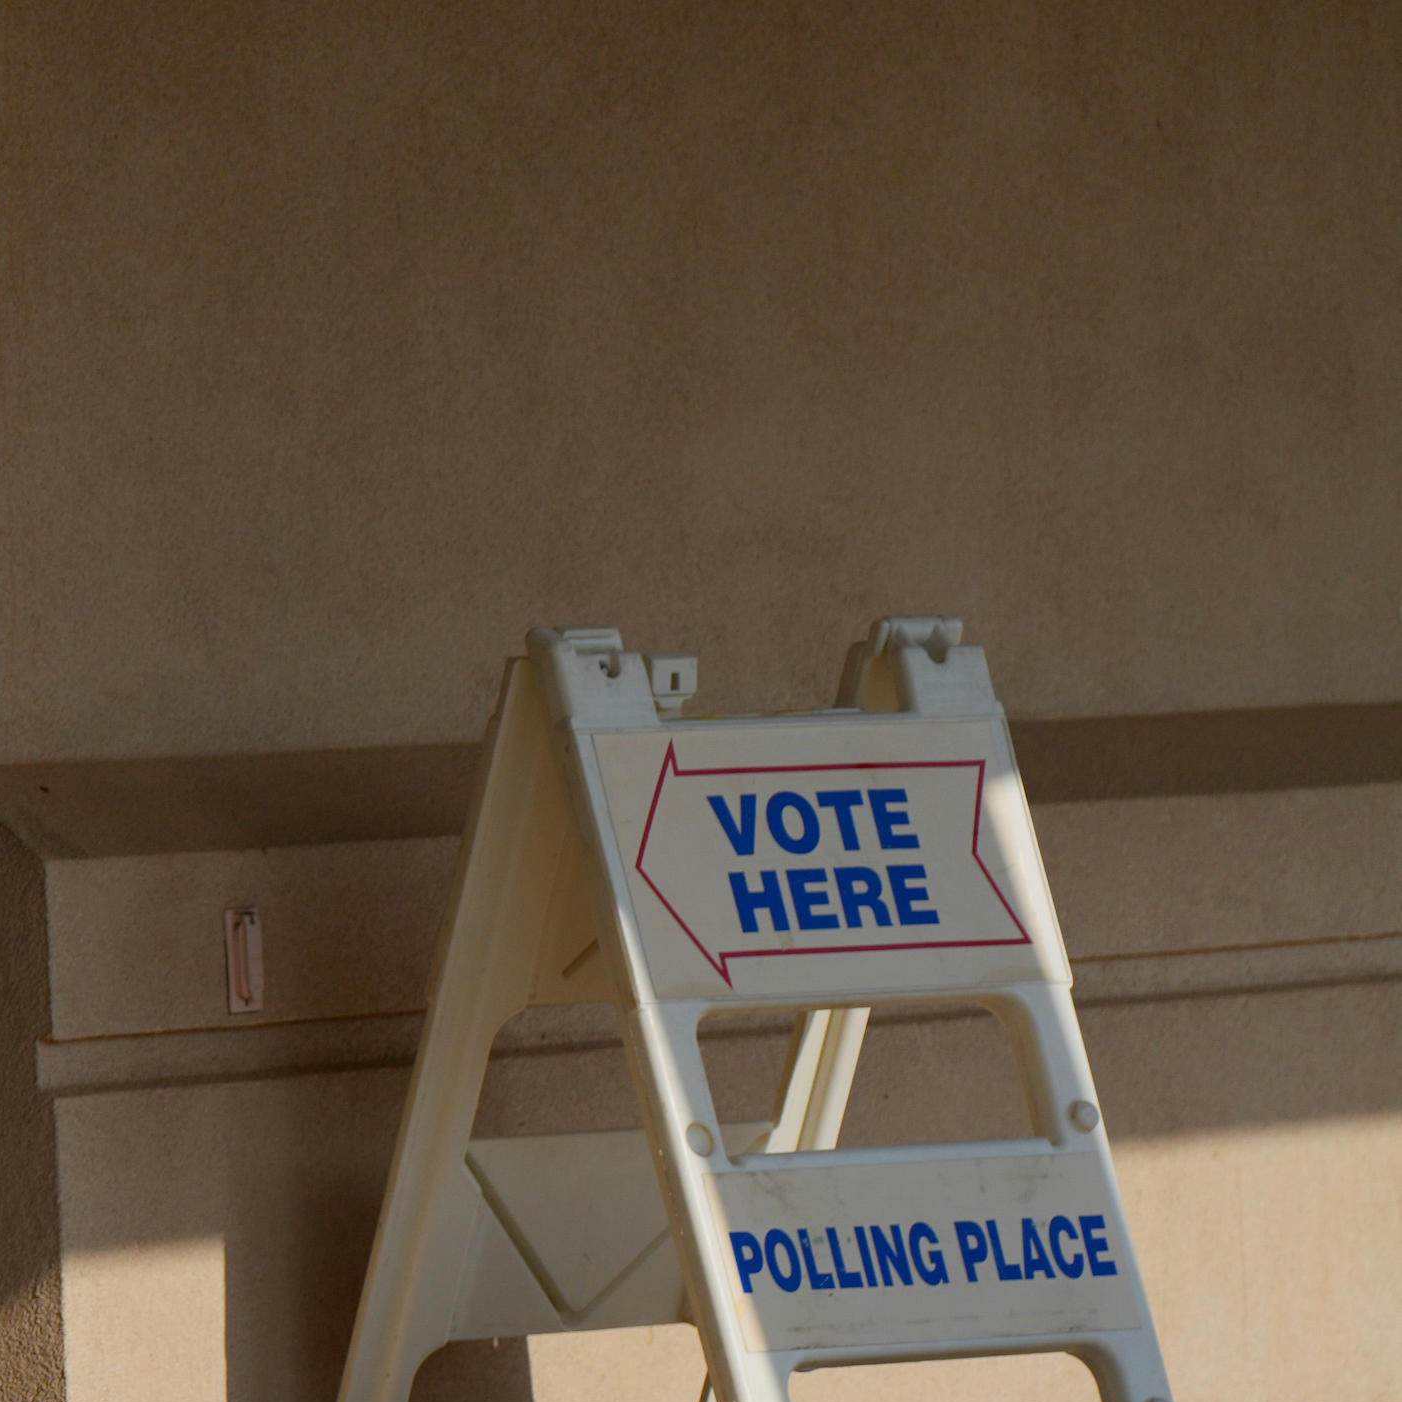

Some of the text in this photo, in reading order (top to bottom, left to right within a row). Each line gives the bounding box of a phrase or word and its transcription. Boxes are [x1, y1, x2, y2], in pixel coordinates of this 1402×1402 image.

[707, 788, 920, 856] VOTE
[728, 864, 940, 933] HERE
[729, 1214, 1117, 1293] POLLING PLACE
